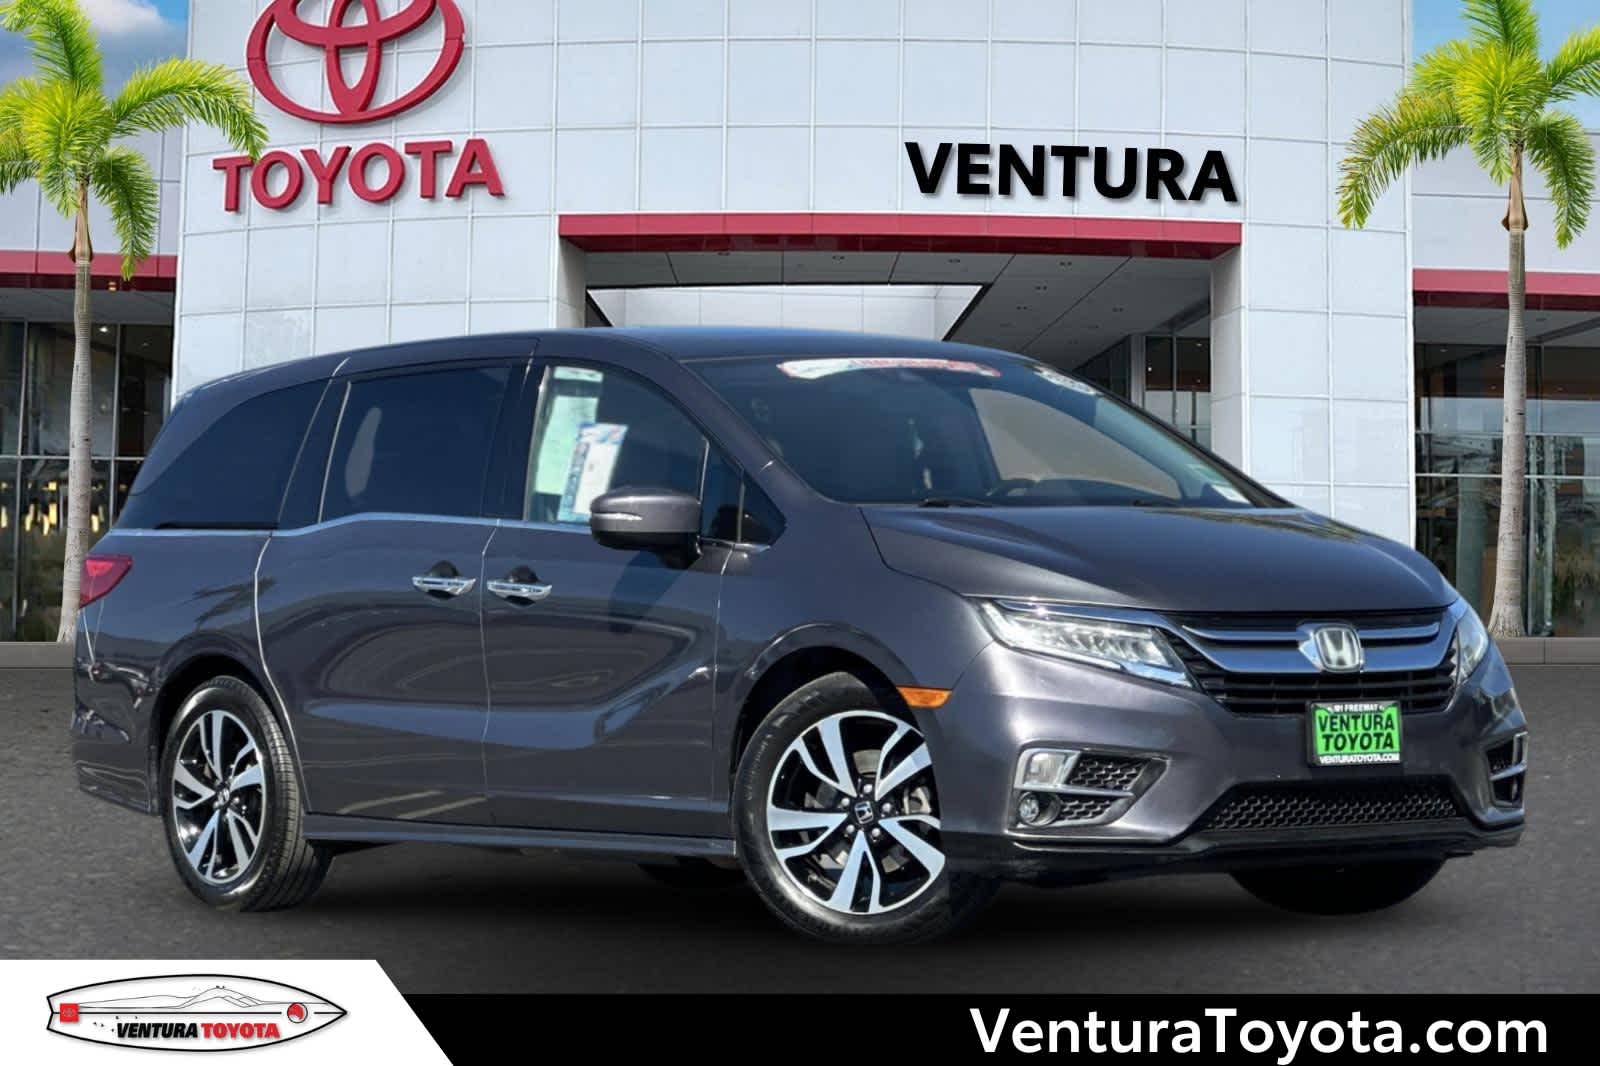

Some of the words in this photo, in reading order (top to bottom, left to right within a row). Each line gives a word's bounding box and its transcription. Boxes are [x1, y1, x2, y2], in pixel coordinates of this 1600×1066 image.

[212, 138, 505, 212] TOYOTA
[904, 141, 1239, 203] VENTURA
[1344, 703, 1379, 712] FREEWAY
[1318, 713, 1395, 732] VENTURA
[1321, 732, 1395, 751] TOYOTA
